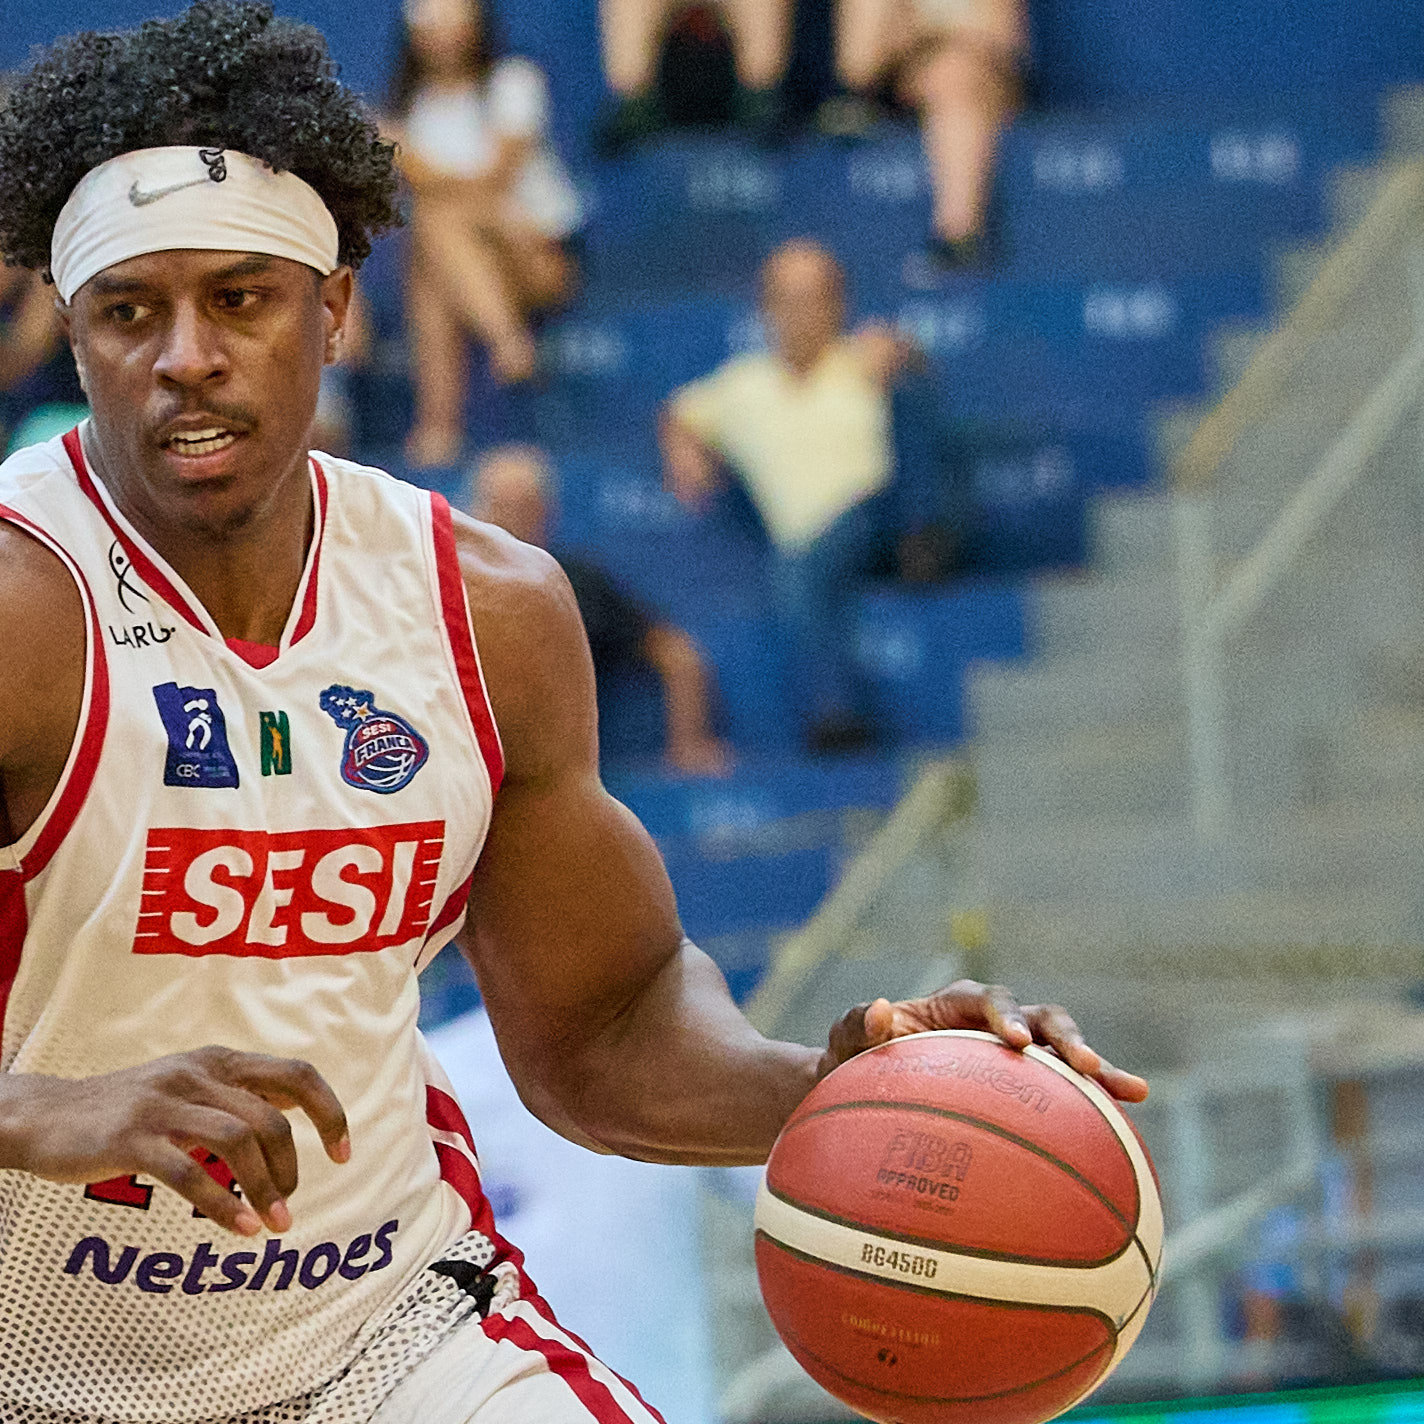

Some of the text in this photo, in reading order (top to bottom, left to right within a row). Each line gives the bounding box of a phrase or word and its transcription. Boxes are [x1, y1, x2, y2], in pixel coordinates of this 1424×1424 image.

[361, 722, 392, 740] SESI
[170, 841, 419, 947] SESI
[877, 1167, 961, 1202] APPROVED
[861, 1243, 938, 1279] BG4500
